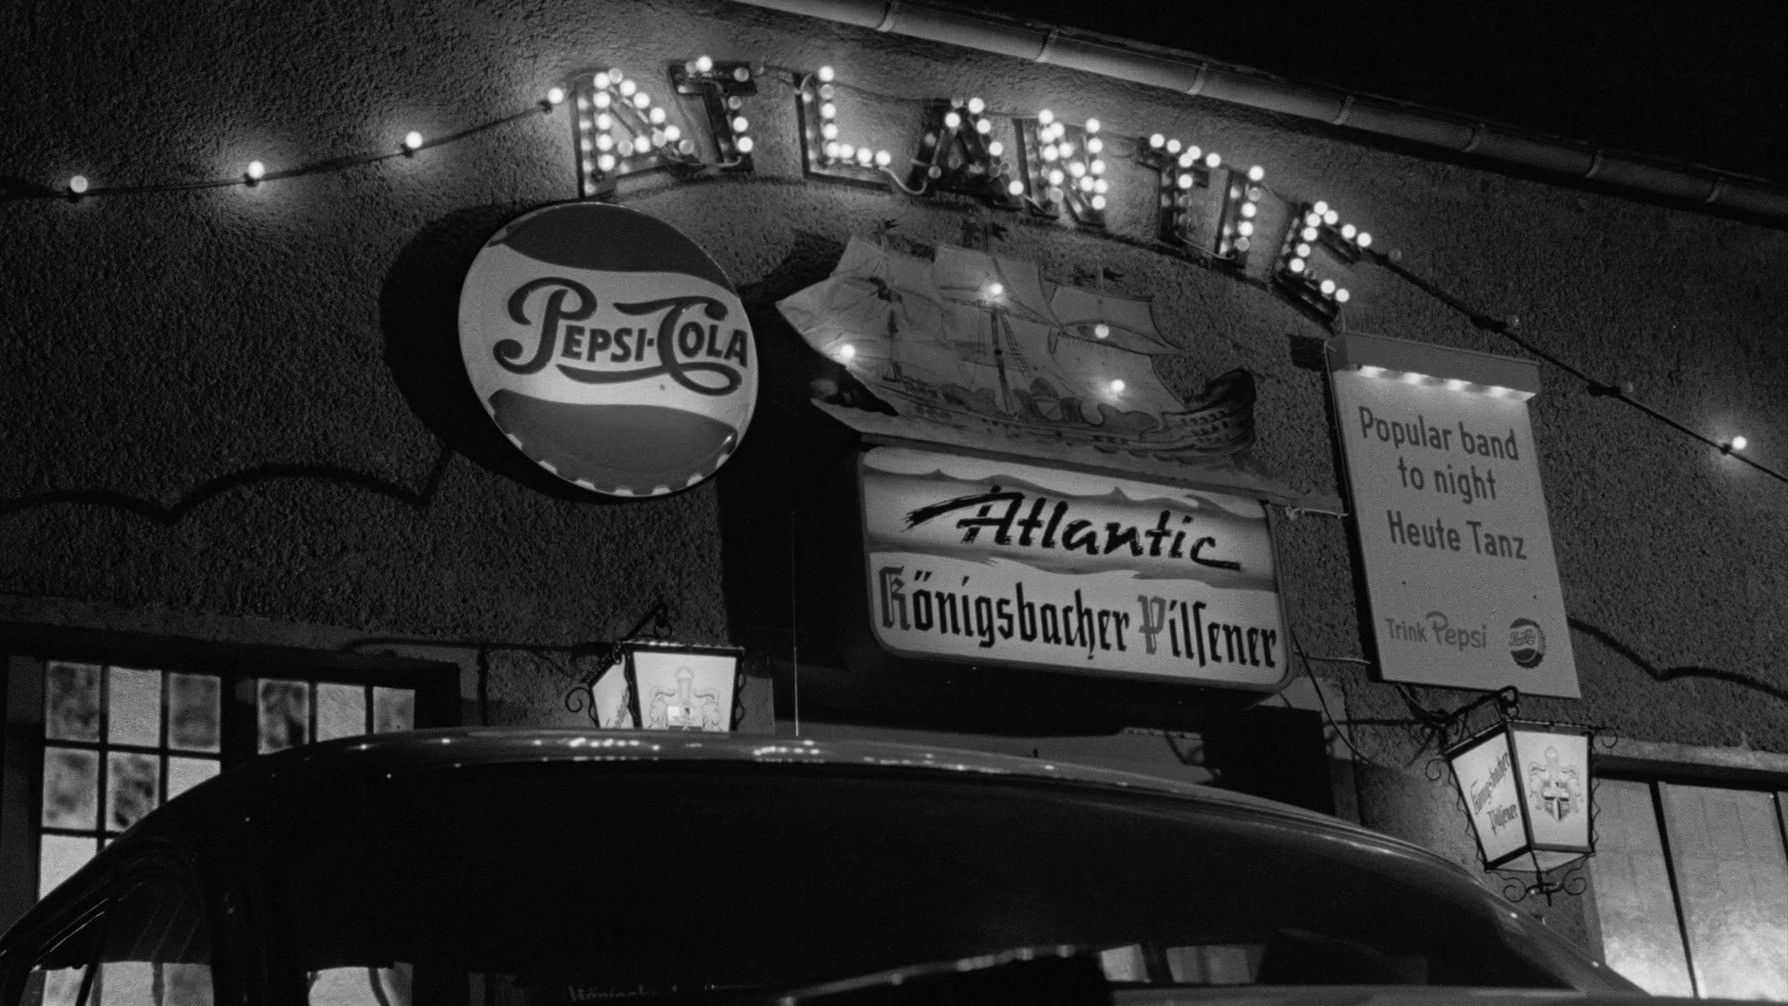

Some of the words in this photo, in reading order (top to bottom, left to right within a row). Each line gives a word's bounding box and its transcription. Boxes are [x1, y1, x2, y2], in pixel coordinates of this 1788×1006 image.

[574, 55, 1372, 320] ATLANTIC
[1358, 405, 1453, 451] Popular
[1458, 421, 1520, 460] band
[1397, 455, 1425, 490] to
[1433, 464, 1497, 504] night
[901, 485, 1241, 572] Atlantic
[1386, 508, 1461, 552] Heute
[1465, 520, 1528, 560] Tanz
[878, 564, 1130, 661] Königsbacher
[1384, 617, 1429, 644] Trink
[1425, 610, 1488, 653] Pepsi
